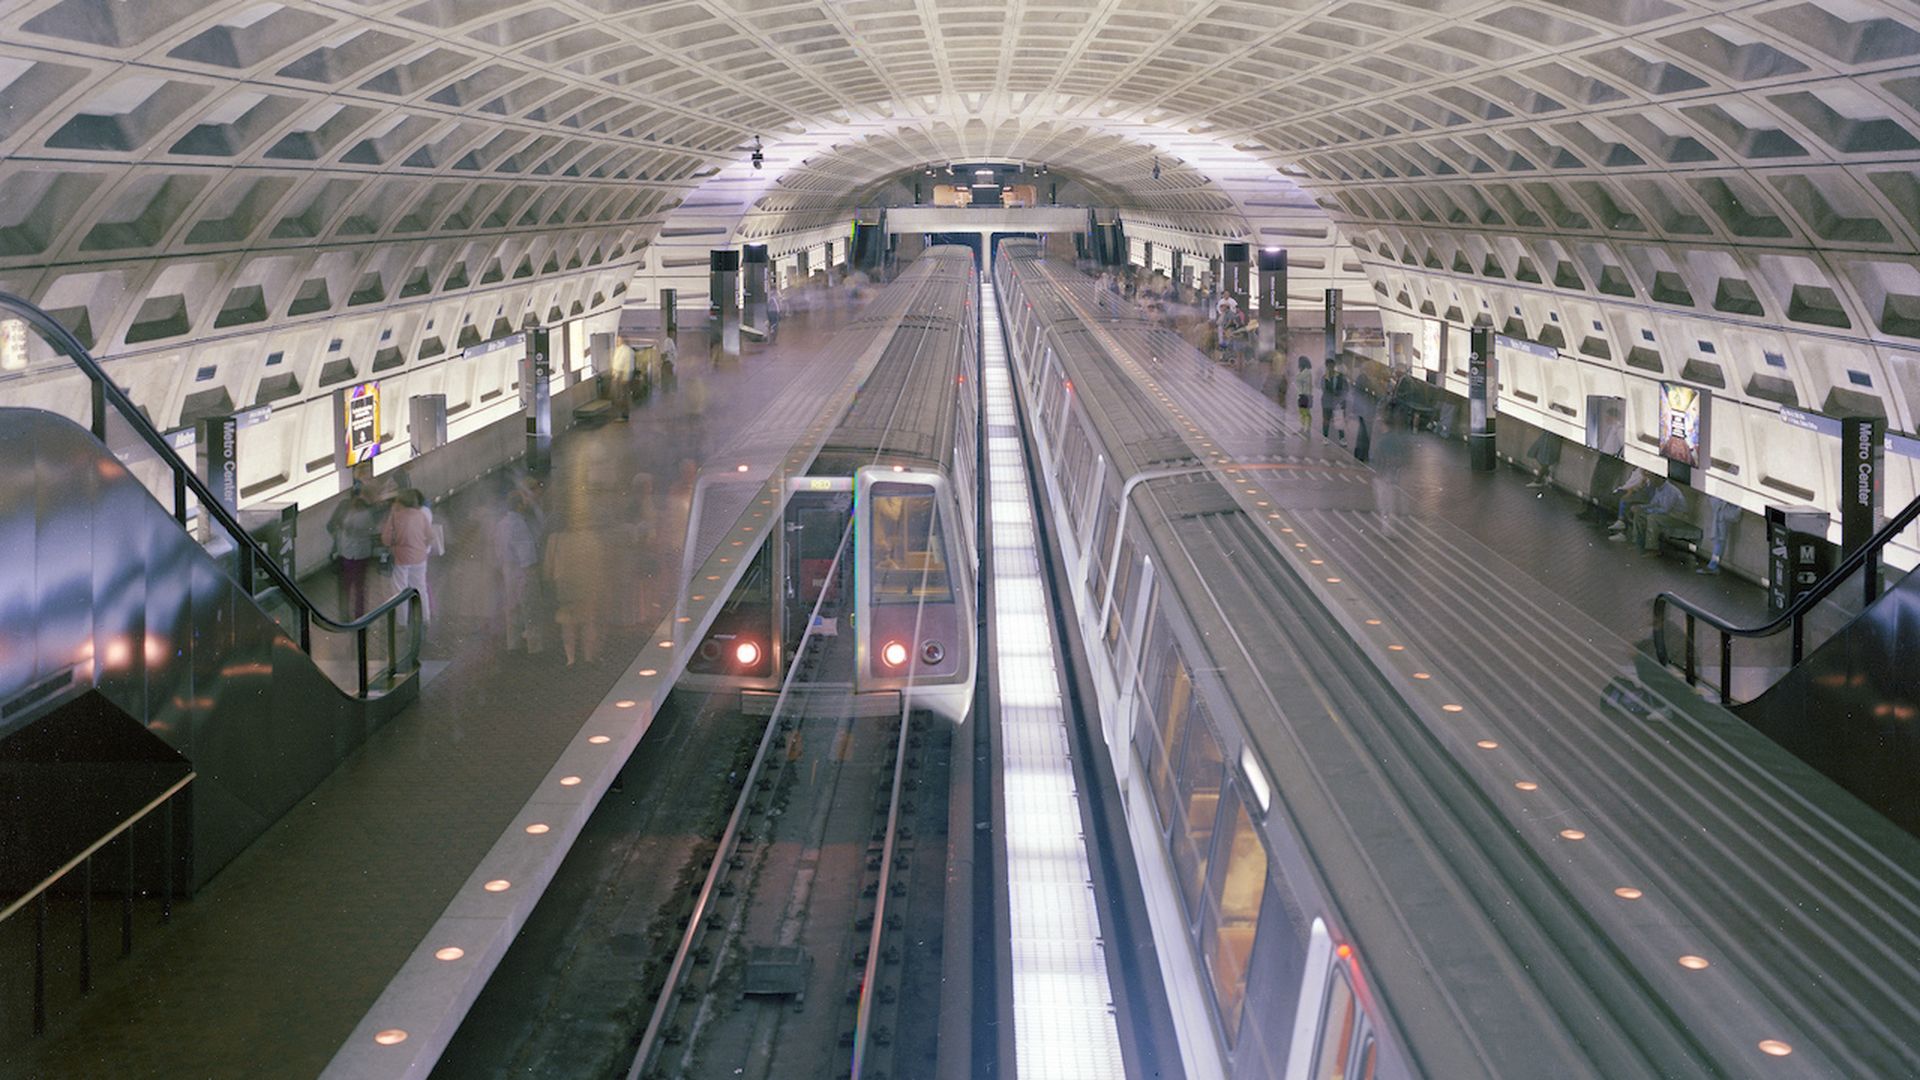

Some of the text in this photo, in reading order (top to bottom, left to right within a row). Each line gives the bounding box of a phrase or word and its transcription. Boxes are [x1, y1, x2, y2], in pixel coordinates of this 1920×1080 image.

[223, 422, 236, 502] Metro Center
[1859, 423, 1873, 506] Metro Center
